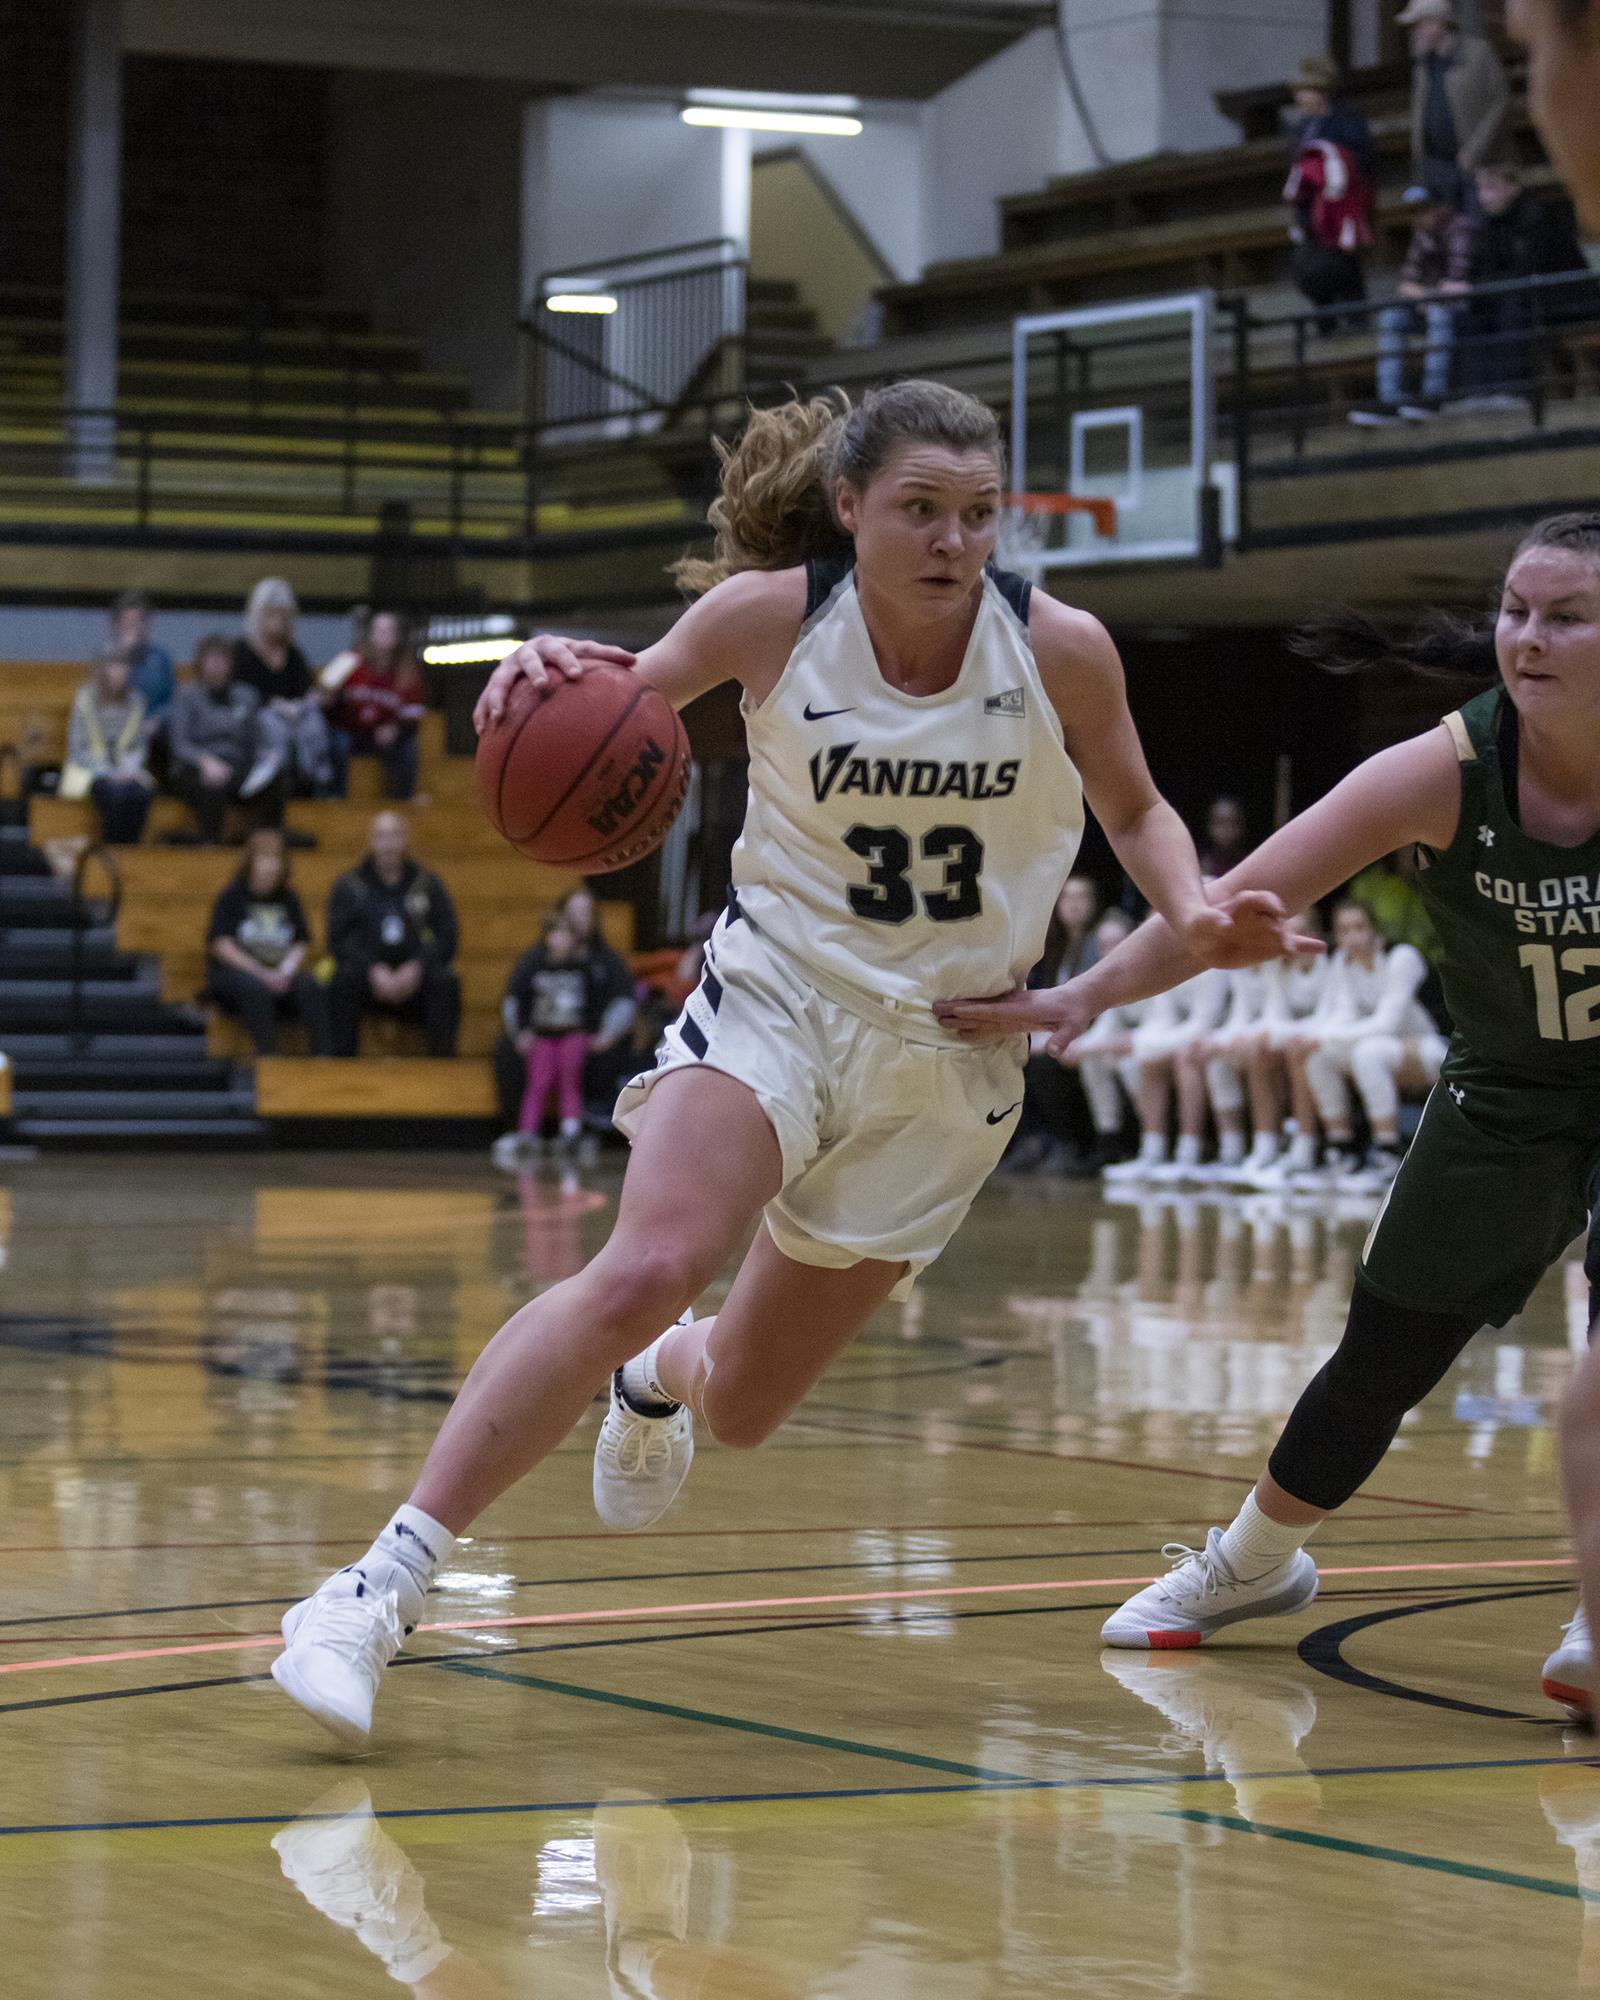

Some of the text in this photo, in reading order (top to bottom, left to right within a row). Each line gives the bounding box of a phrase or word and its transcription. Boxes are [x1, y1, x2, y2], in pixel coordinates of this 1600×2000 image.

[809, 740, 1022, 804] VANDALS
[841, 823, 985, 927] 33
[1475, 871, 1600, 907] COLOR
[1518, 943, 1600, 1041] 12
